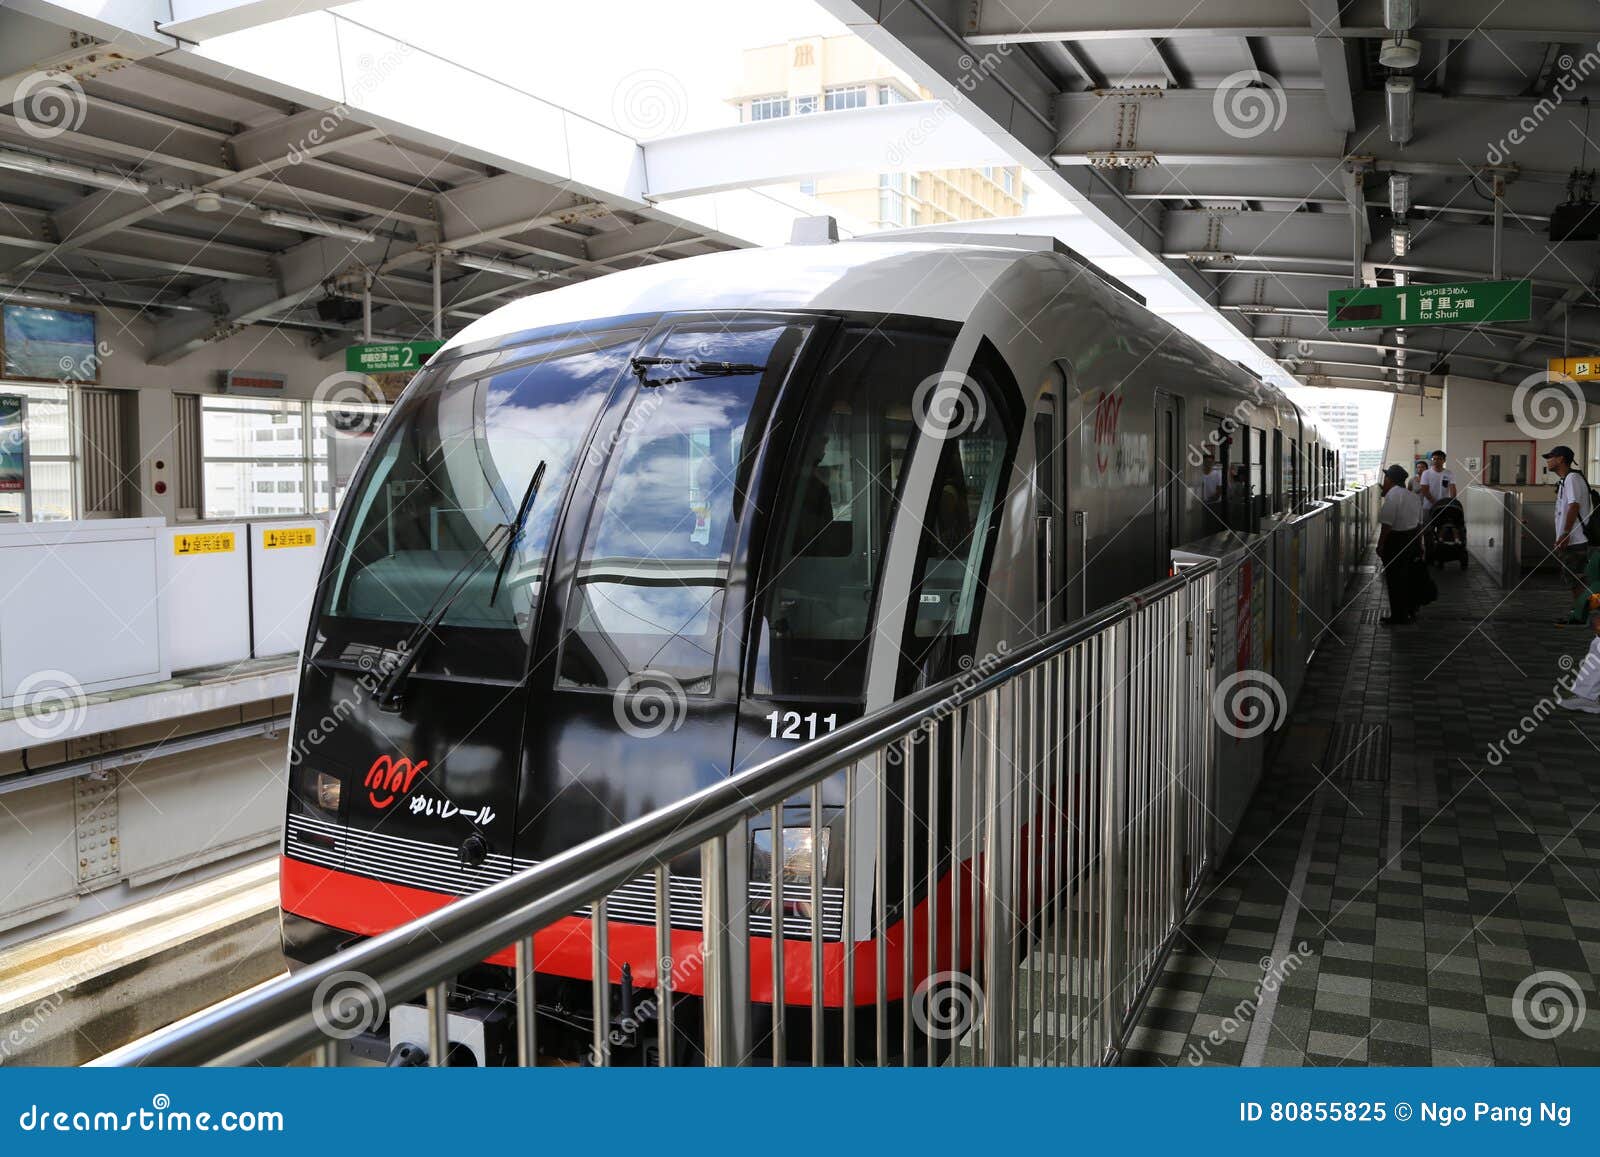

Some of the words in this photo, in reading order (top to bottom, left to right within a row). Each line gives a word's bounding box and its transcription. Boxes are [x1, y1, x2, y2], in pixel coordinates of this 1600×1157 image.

[1396, 293, 1407, 321] 1
[1420, 311, 1433, 319] for
[1435, 309, 1459, 319] Shuri
[402, 347, 413, 367] 2
[766, 710, 837, 740] 1211
[409, 794, 496, 825] ゆいレール
